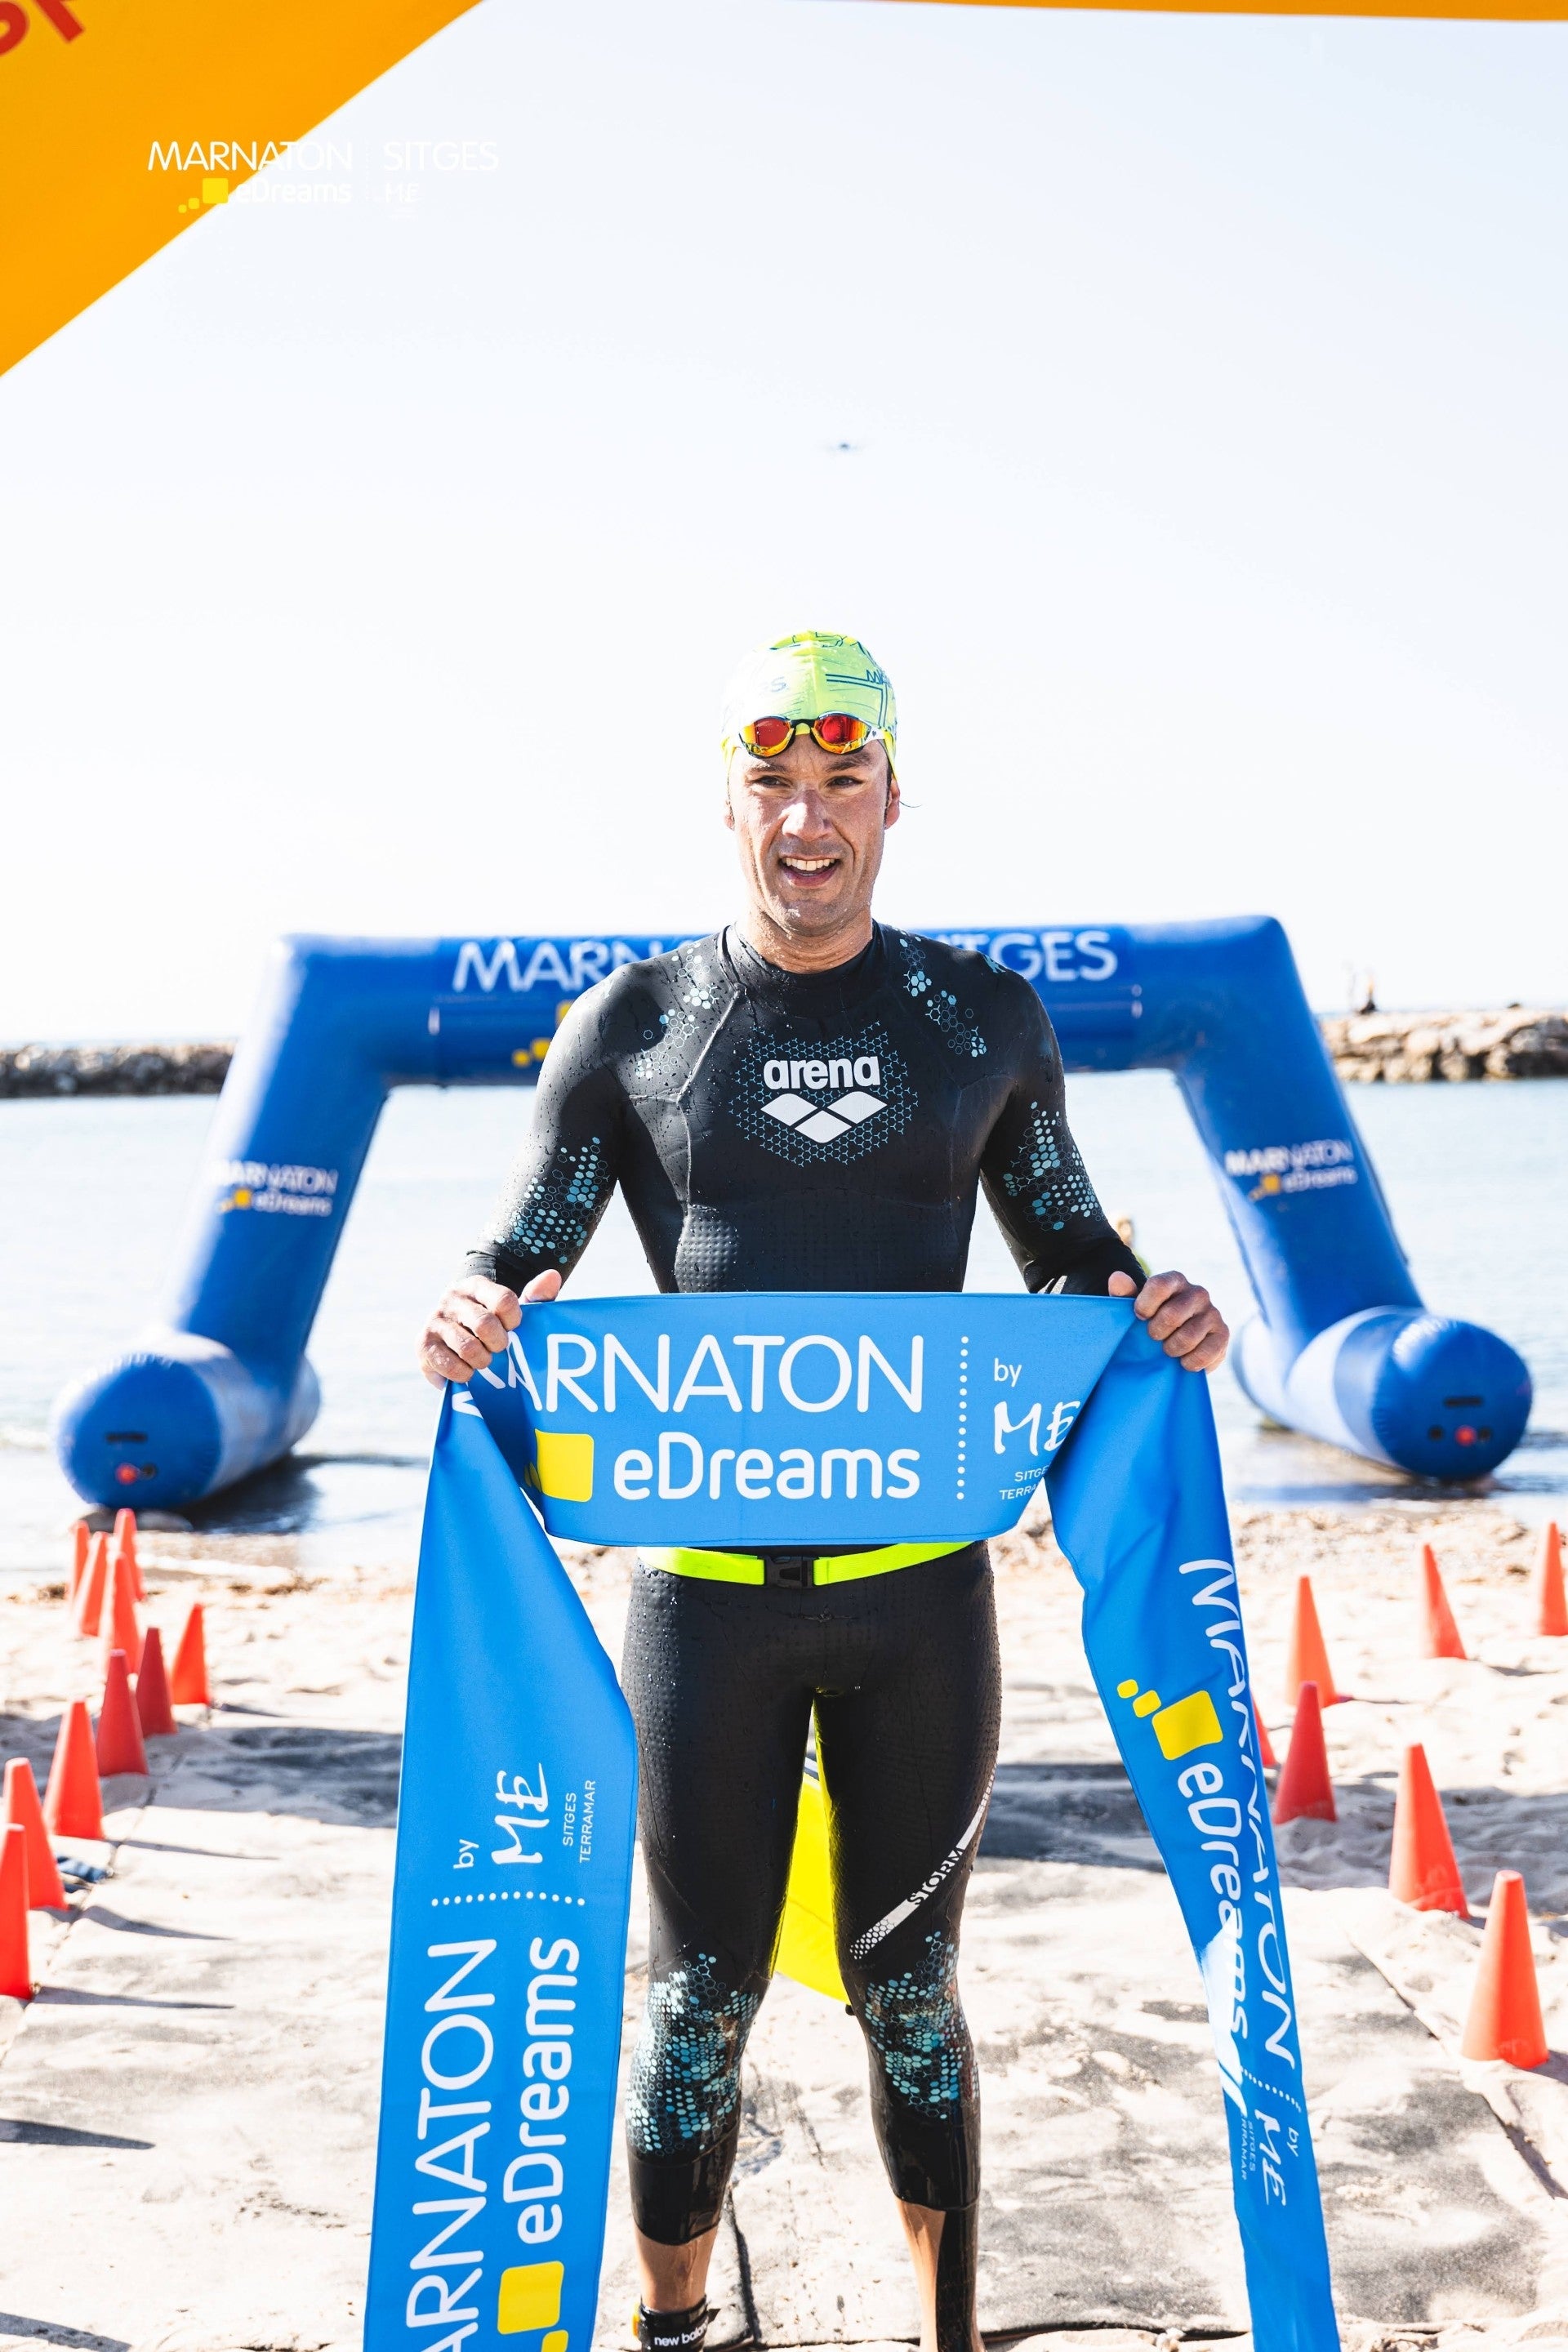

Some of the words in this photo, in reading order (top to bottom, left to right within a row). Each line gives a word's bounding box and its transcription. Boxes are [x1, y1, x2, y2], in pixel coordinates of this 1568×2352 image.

[764, 1056, 880, 1089] arena
[994, 1357, 1022, 1387] by
[994, 1401, 1080, 1456] ME
[613, 1432, 920, 1499] eDreams
[999, 1483, 1038, 1500] TERRA
[1014, 1465, 1049, 1482] SITGE
[491, 1762, 550, 1864] ME
[563, 1793, 577, 1846] SITGES
[580, 1780, 596, 1863] TERRAMAR
[452, 1839, 479, 1869] by
[907, 1847, 964, 1905] STORM
[503, 1936, 579, 2244] eDreams
[1254, 2109, 1286, 2206] ME
[1286, 2127, 1299, 2158] by
[654, 2336, 679, 2346] new
